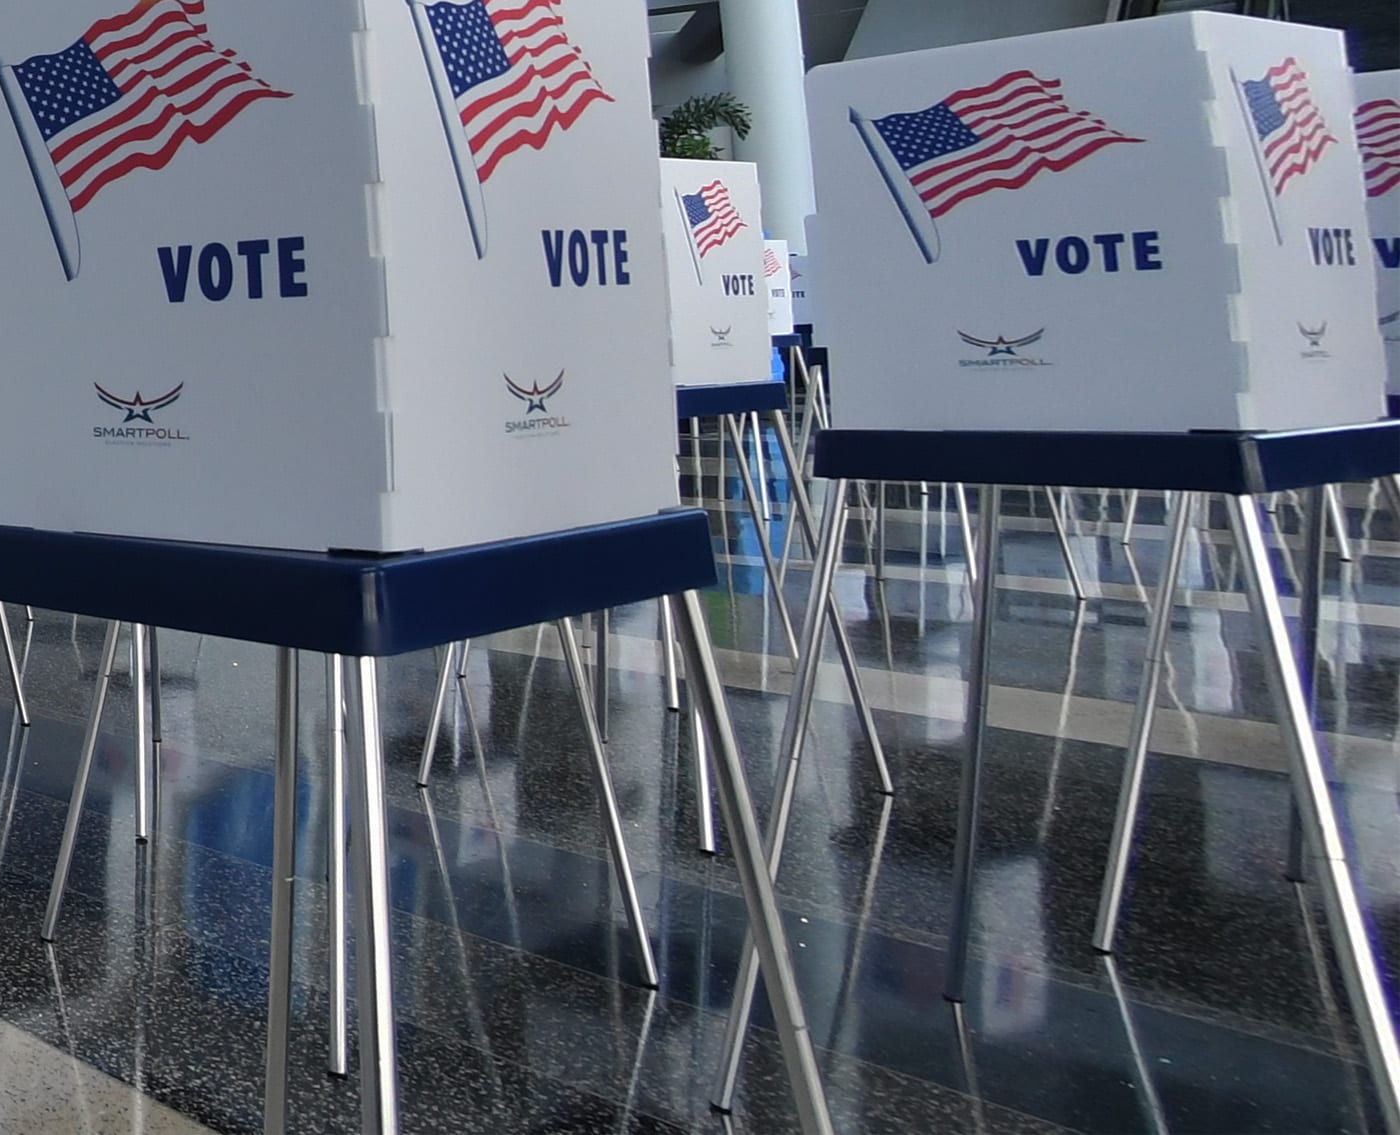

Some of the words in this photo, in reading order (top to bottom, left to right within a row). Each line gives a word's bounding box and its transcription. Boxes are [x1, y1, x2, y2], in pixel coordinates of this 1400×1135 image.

[541, 229, 630, 287] VOTE
[1015, 231, 1163, 276] VOTE
[1308, 228, 1355, 265] VOTE
[157, 236, 308, 303] VOTE
[722, 275, 754, 296] VOTE
[93, 426, 187, 440] SMARTPOLL
[505, 416, 569, 433] SMARTPOLL
